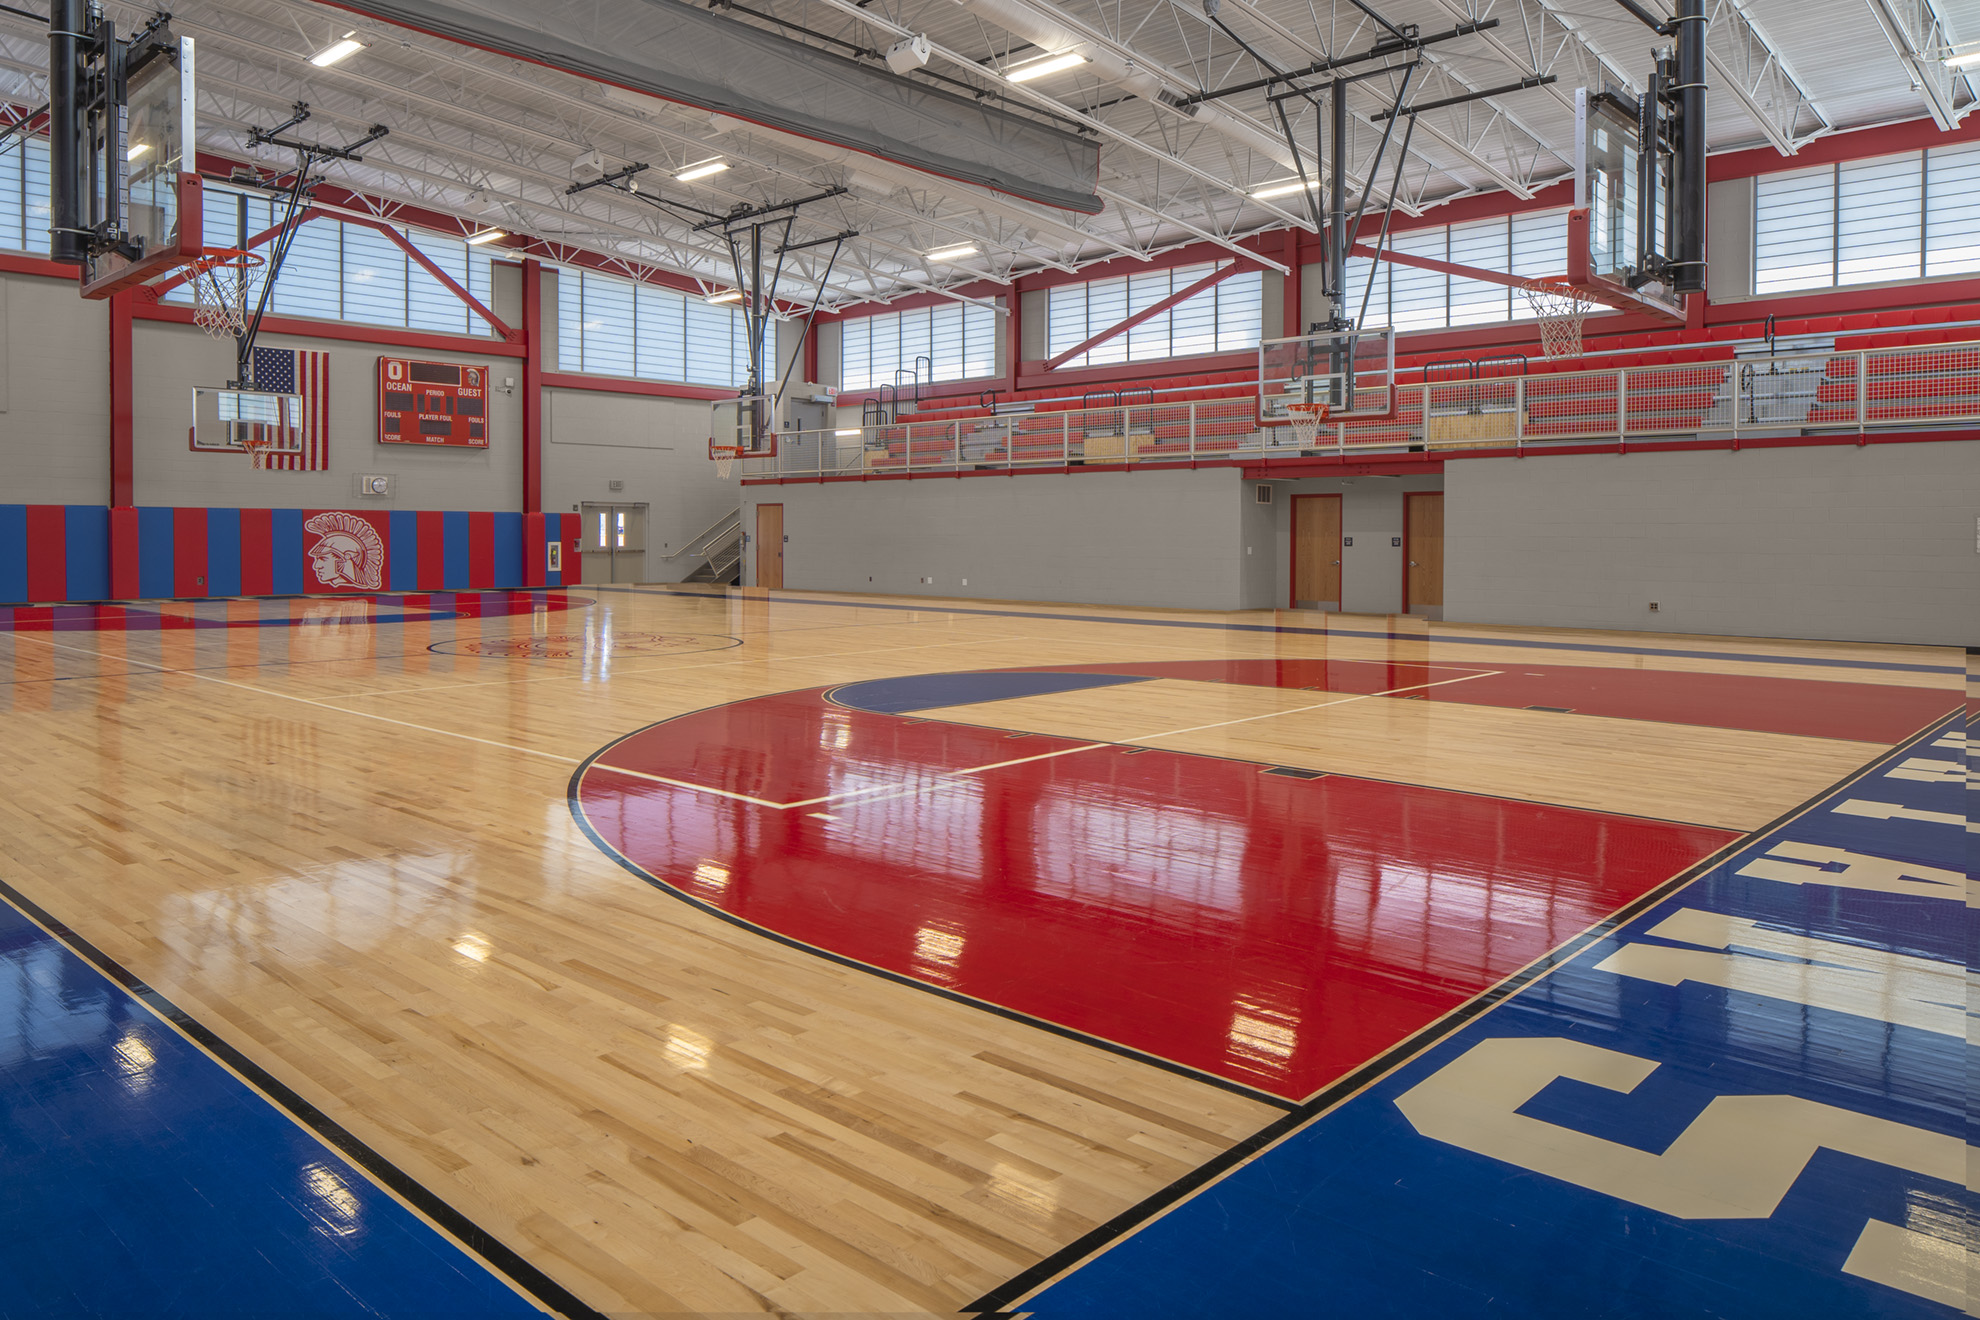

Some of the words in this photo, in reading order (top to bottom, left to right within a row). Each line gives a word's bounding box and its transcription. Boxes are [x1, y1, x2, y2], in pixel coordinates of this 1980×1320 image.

[388, 361, 402, 380] O
[386, 381, 412, 392] OCEAN
[457, 387, 481, 397] GUEST
[418, 413, 439, 421] PLAYER
[468, 416, 484, 424] FOULS
